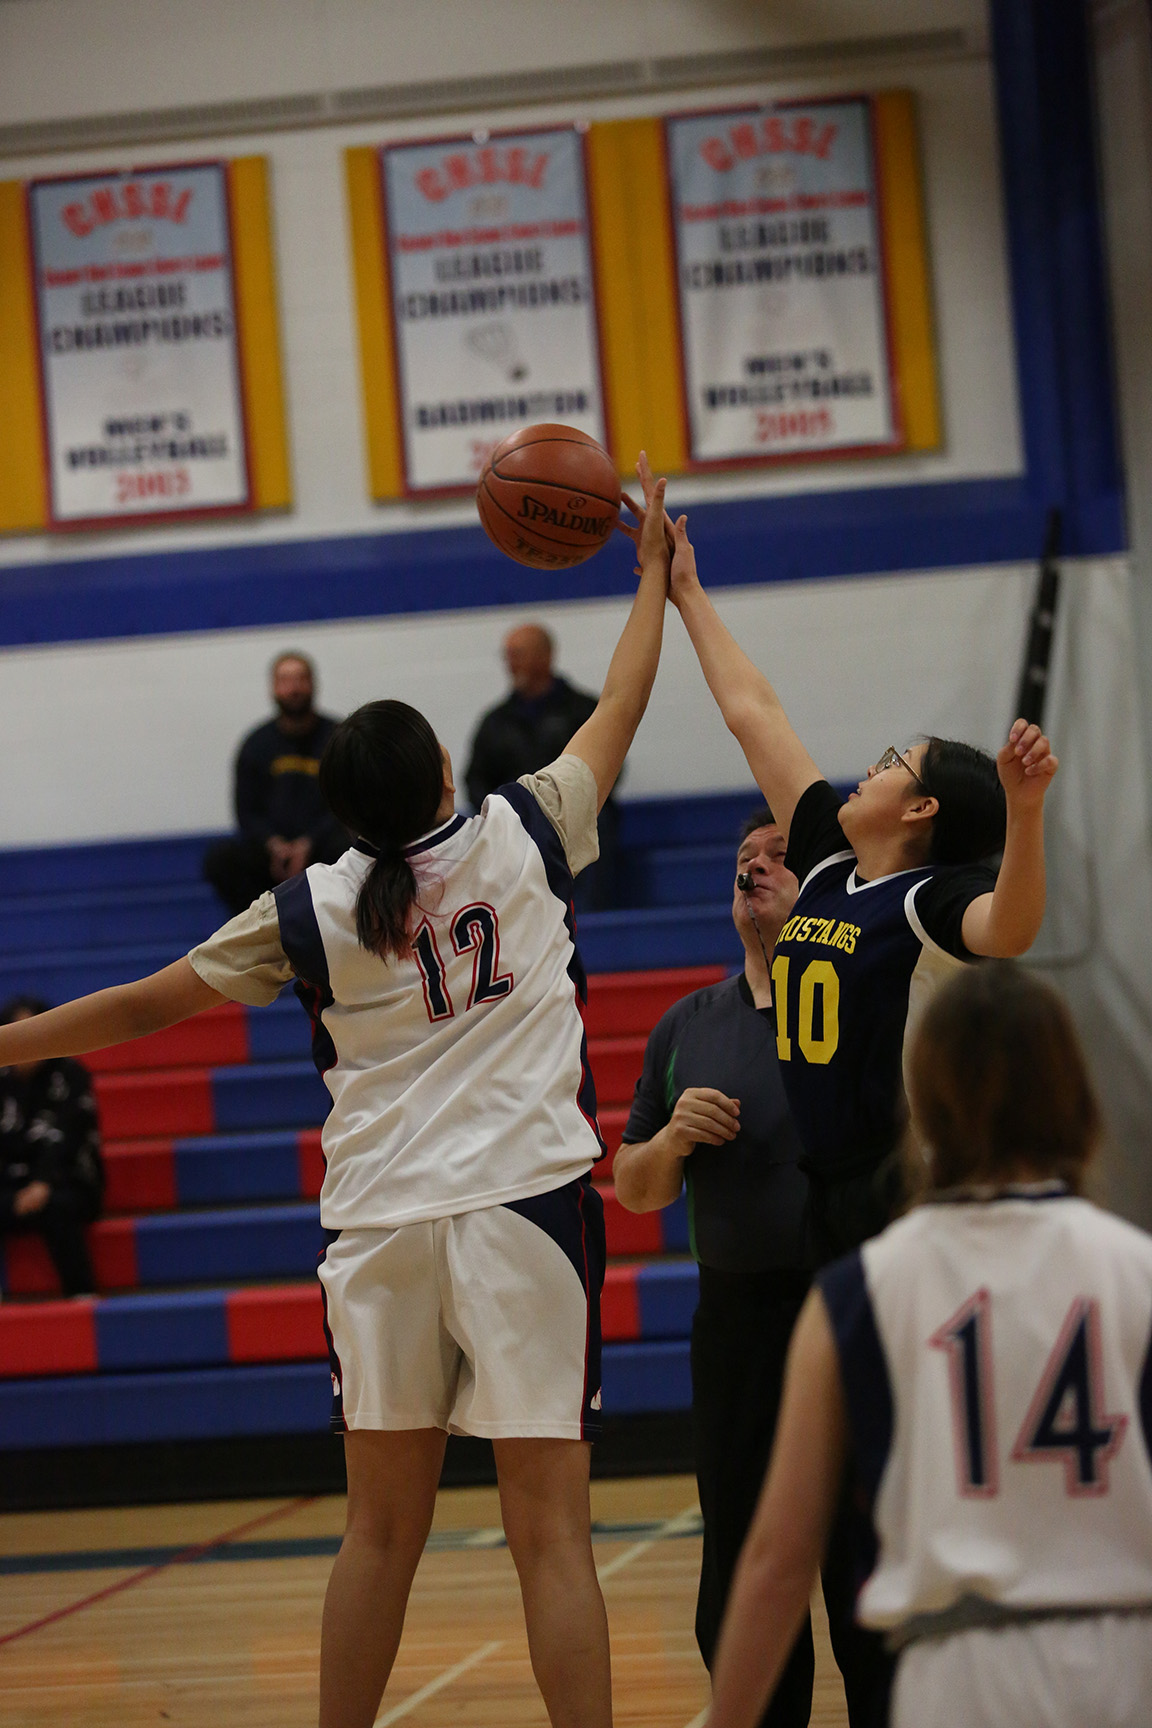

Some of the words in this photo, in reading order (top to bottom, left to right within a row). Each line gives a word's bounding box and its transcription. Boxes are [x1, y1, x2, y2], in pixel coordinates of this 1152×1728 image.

[517, 495, 611, 537] SPALDING
[410, 901, 514, 1023] 12
[771, 955, 840, 1065] 10
[927, 1286, 1130, 1498] 14
